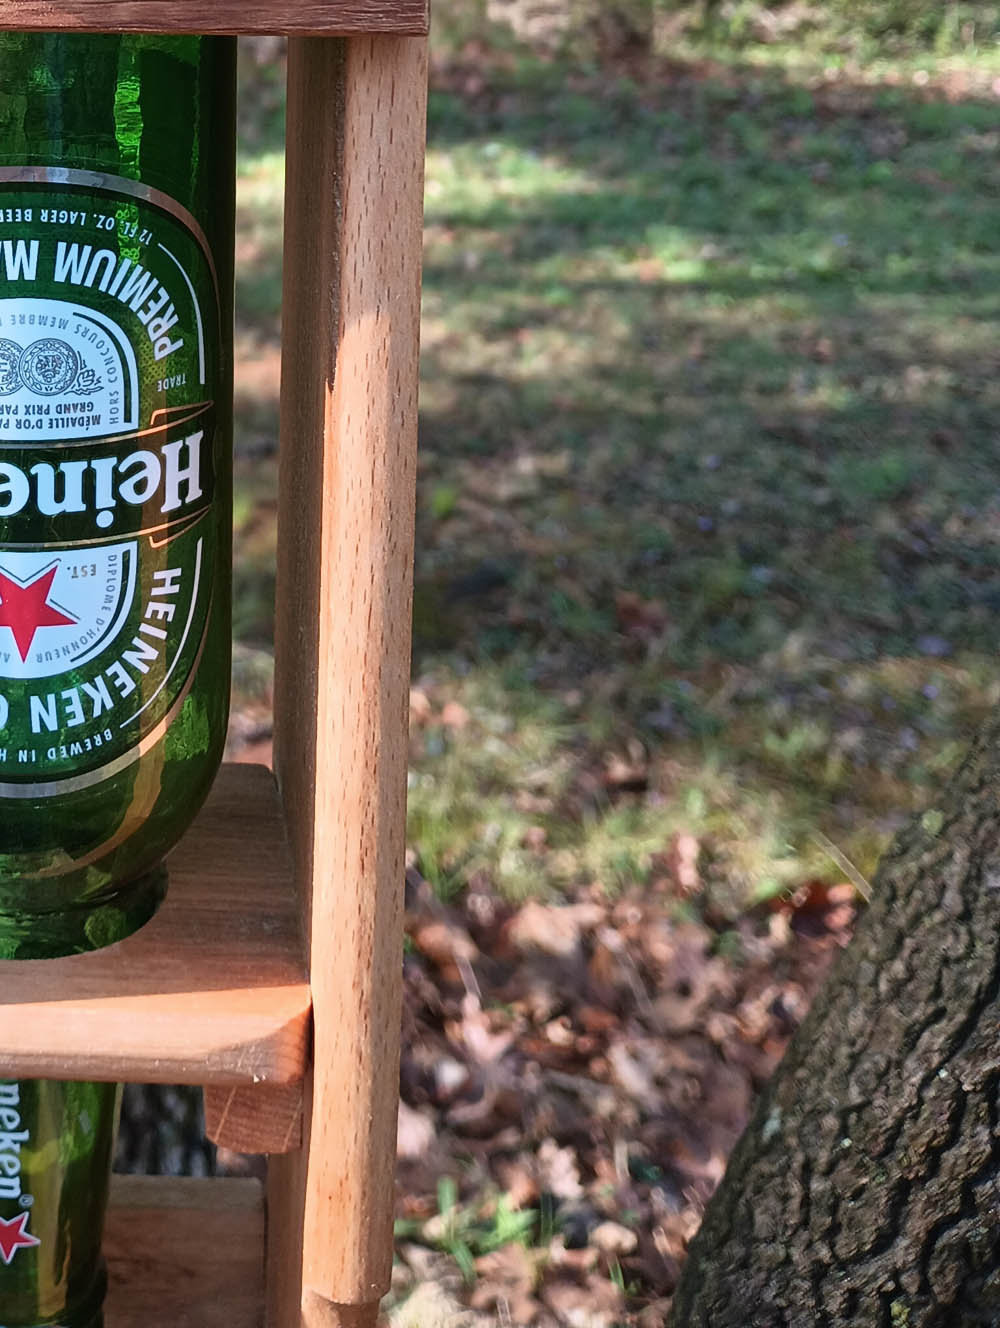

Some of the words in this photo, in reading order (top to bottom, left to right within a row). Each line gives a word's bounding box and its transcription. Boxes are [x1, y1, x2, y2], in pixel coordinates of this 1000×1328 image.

[40, 209, 86, 226] LAGER
[93, 214, 115, 230] OZ.
[139, 228, 153, 245] 12
[53, 241, 184, 361] PREMIUM
[10, 314, 69, 330] MEMBRE
[73, 324, 118, 383] CONCOURS
[156, 373, 186, 392] TRADE
[24, 404, 50, 416] PRIX
[55, 402, 94, 415] GRAND
[109, 390, 120, 424] HORS
[15, 418, 43, 429] D'OR
[48, 415, 101, 431] MÉDAILLE
[67, 564, 96, 578] EST.
[101, 554, 117, 612] DIPLOME
[35, 618, 102, 664] D'HONNEUR
[29, 568, 182, 734] HEINEKEN
[47, 728, 112, 760] BREWED
[18, 749, 36, 762] IN
